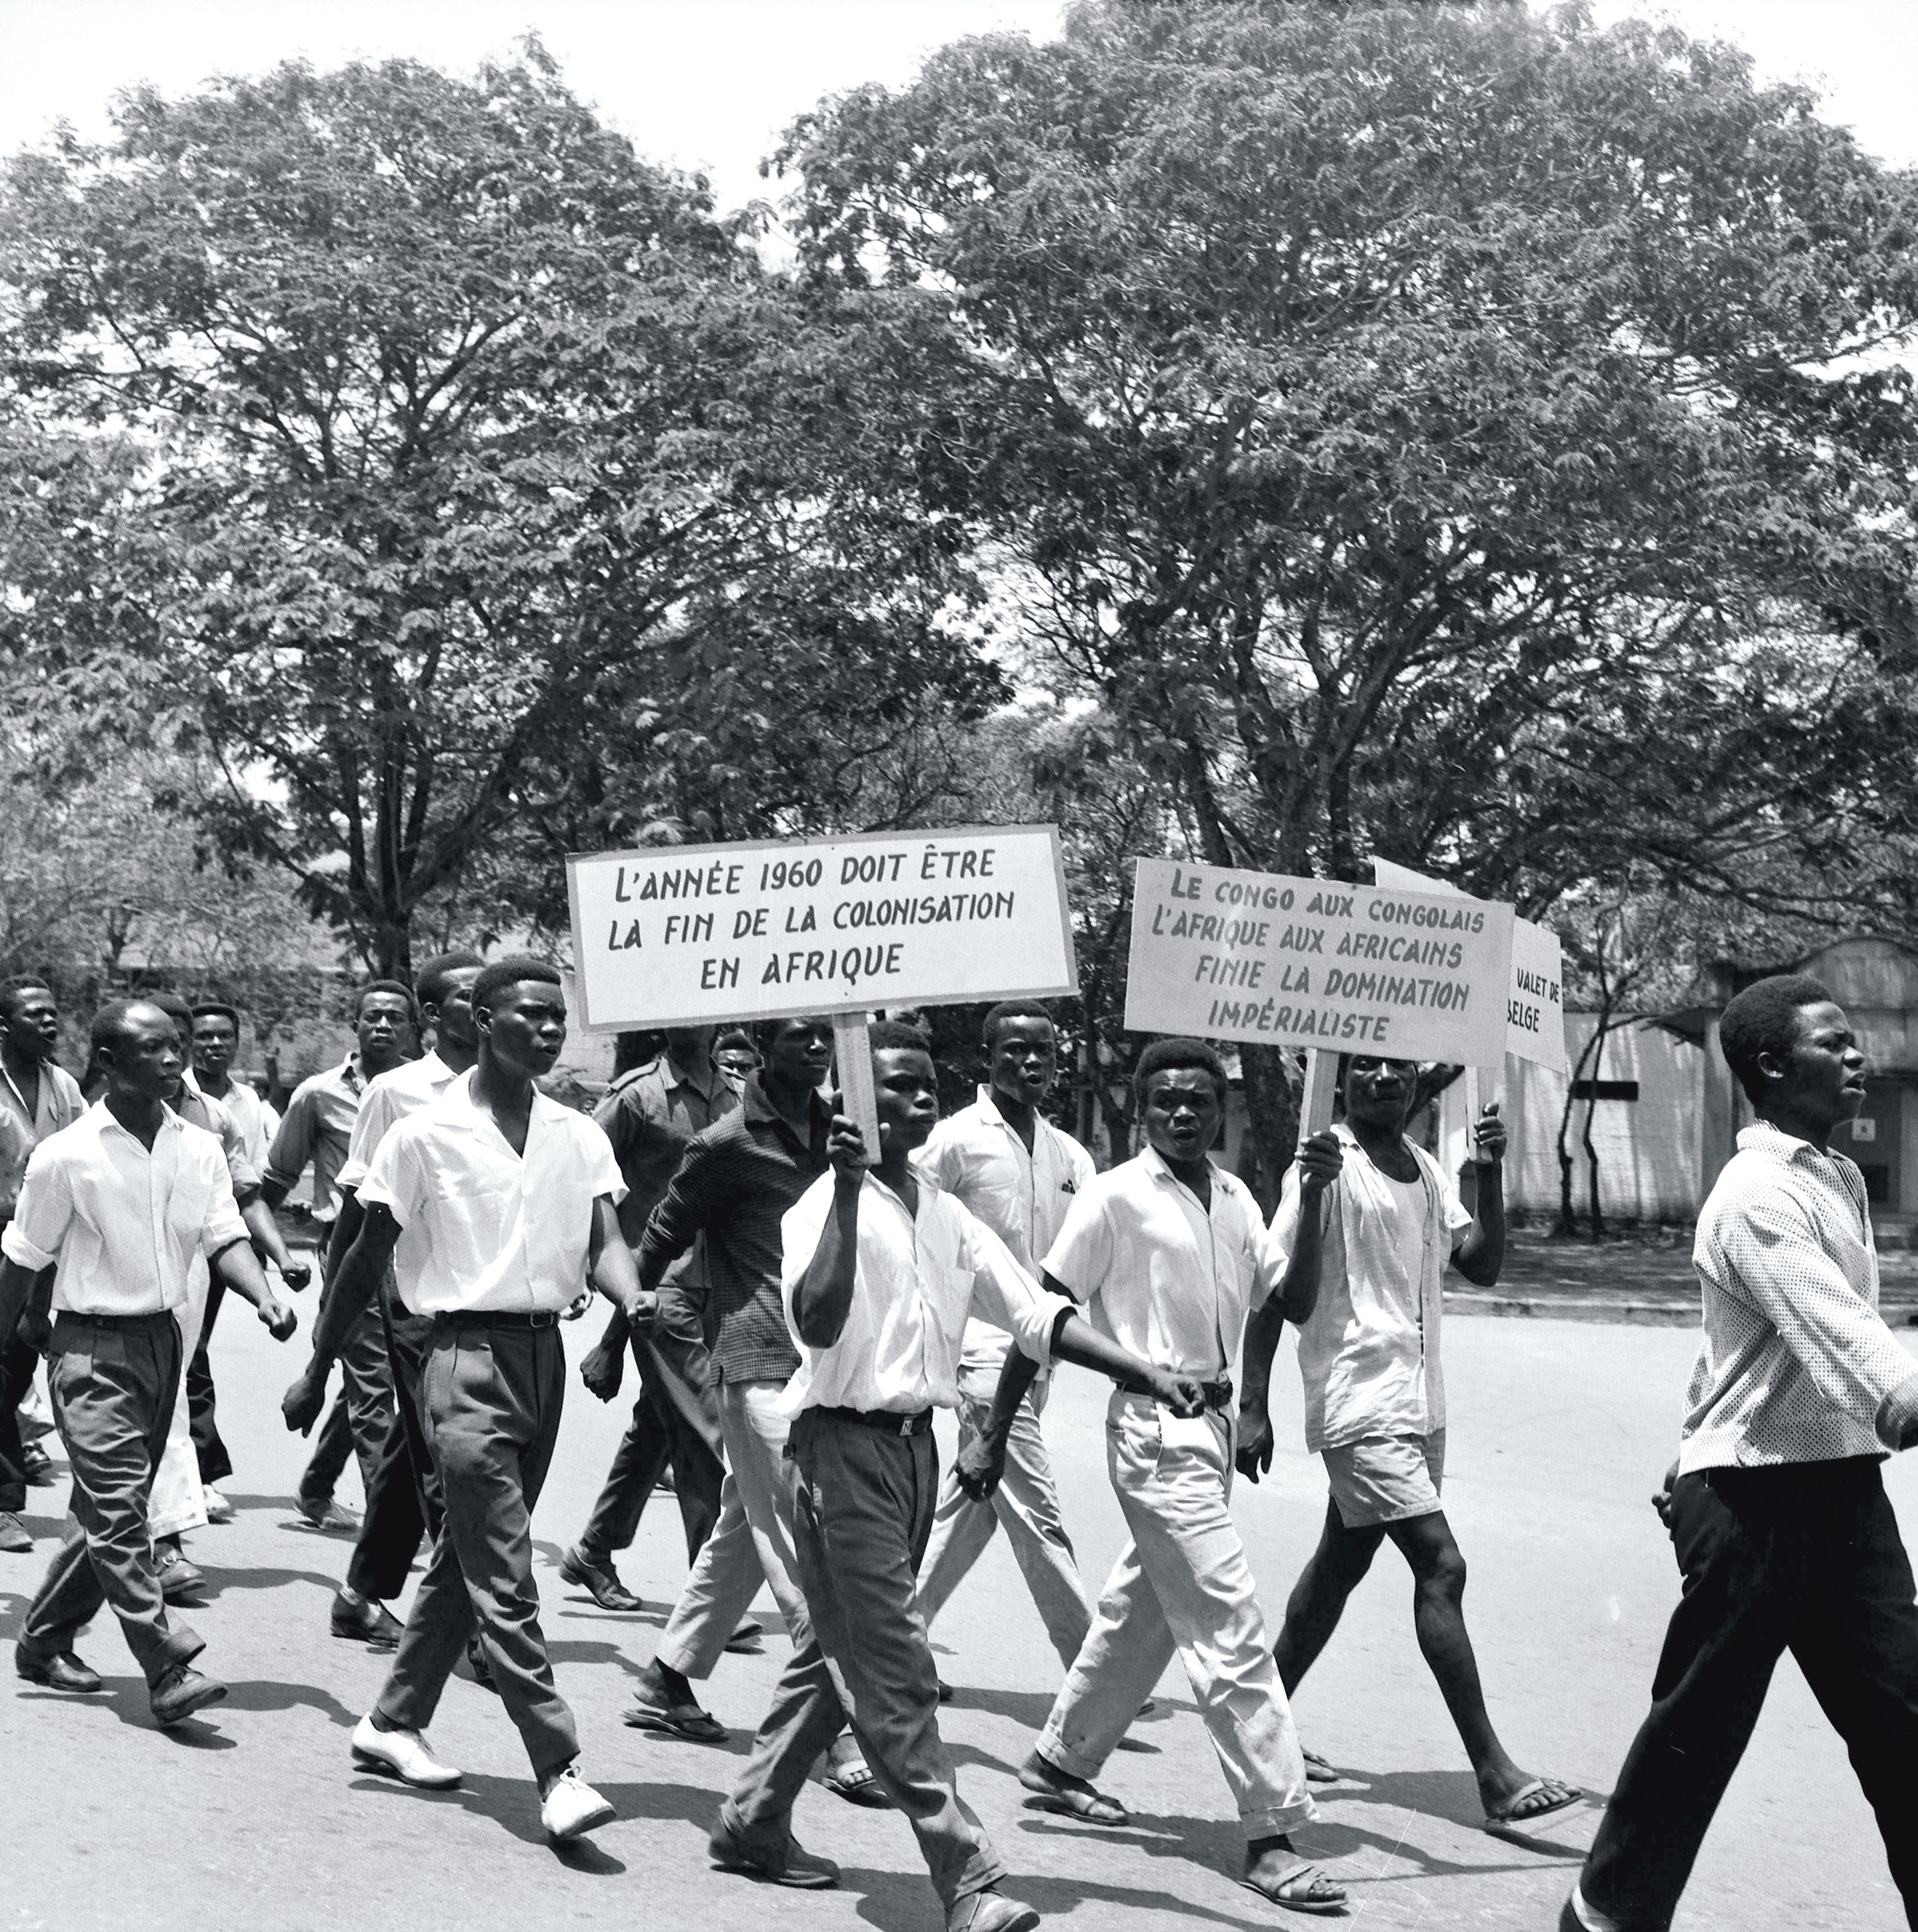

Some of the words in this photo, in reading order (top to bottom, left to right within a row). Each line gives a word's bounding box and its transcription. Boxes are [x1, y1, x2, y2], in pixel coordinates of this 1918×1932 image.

[615, 860, 743, 902] L'ANNÉE
[760, 859, 822, 891] 1960
[841, 854, 907, 885] DOIT
[921, 844, 995, 880] ÊTRE
[1171, 868, 1202, 900] LE
[1215, 881, 1295, 911] CONGO
[1306, 892, 1354, 918] AUX
[1368, 900, 1484, 933] CONGOLAIS
[609, 919, 642, 950] LA
[665, 913, 713, 945] FIN
[733, 908, 769, 939] DE
[785, 906, 816, 932] LA
[833, 892, 1014, 929] COLONISATION
[1152, 903, 1270, 950] L'AFRIQUE
[1280, 924, 1324, 954] AUX
[1336, 932, 1462, 969] AFRICAINS
[701, 957, 740, 989] EN
[762, 944, 904, 986] AFRIQUE
[1195, 955, 1266, 988] FINIE
[1280, 965, 1309, 993] LA
[1324, 969, 1469, 1011] DOMINATION
[1517, 968, 1547, 997] VALET
[1550, 982, 1559, 1004] DE
[1209, 997, 1390, 1041] IMPÉRIALISTE
